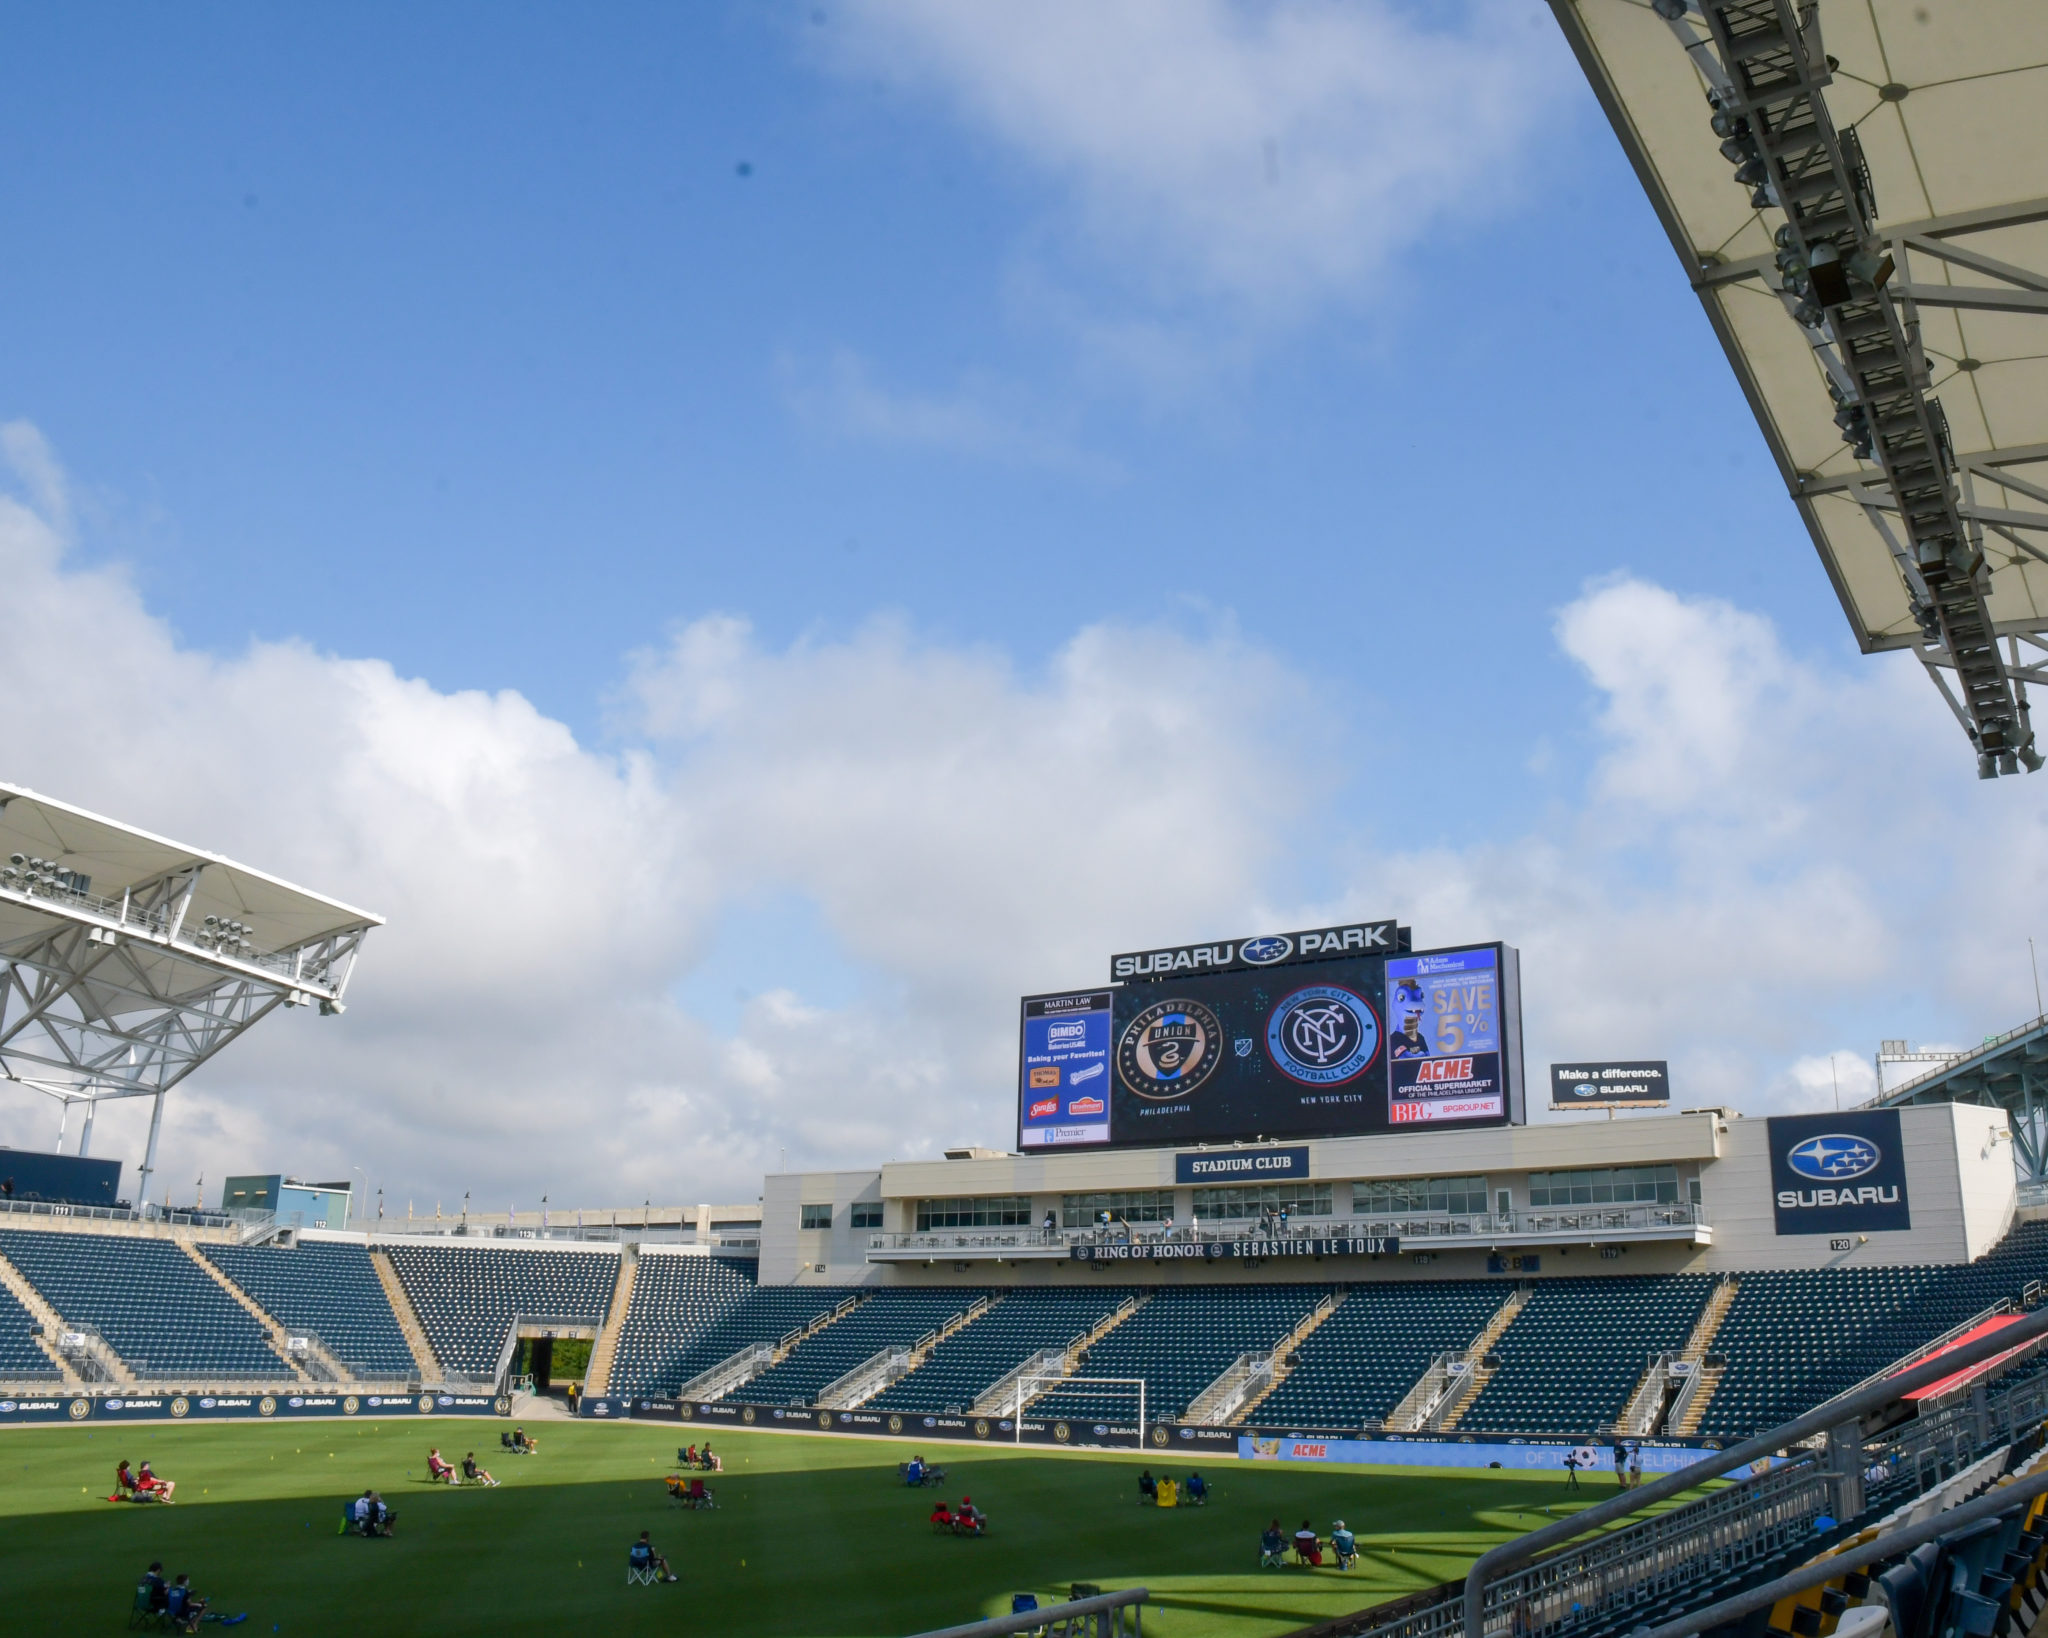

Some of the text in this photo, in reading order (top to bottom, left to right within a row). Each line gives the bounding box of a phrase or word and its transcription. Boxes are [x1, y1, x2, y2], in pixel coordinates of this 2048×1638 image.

[1115, 925, 1390, 977] SUBARU PARK
[1330, 989, 1355, 1003] CITY
[1433, 985, 1491, 1014] SAVE
[1044, 997, 1092, 1009] MARTIN LAW
[1125, 1003, 1218, 1046] PHILADELPHIA
[1050, 1025, 1084, 1039] BIMBO
[1154, 1025, 1192, 1039] UNION
[1027, 1055, 1052, 1063] Baking
[1053, 1054, 1069, 1062] your
[1282, 1053, 1367, 1081] FOOTBALL CLUB
[1416, 1057, 1474, 1084] ACME
[1558, 1068, 1662, 1080] Make a difference.
[1398, 1079, 1493, 1094] OFFICIAL SUPERMARKET
[1600, 1085, 1648, 1094] SUBARU
[1300, 1094, 1364, 1105] NEW YORK CITY
[1139, 1105, 1191, 1117] PHILADELPHIA
[1443, 1102, 1496, 1113] BPGROUP.NET
[1055, 1127, 1085, 1138] Premier
[1192, 1156, 1292, 1173] STADIUM CLUB
[1777, 1185, 1899, 1208] SUBARU
[54, 1206, 69, 1215] 111
[315, 1220, 327, 1229] 112
[1094, 1246, 1129, 1258] RING
[1131, 1245, 1150, 1258] OF
[1153, 1244, 1204, 1258] HONOR
[1233, 1241, 1314, 1257] SEBASTIEN
[1322, 1239, 1339, 1254] LE
[1347, 1238, 1386, 1254] TOUX
[1831, 1240, 1849, 1250] 120
[19, 1402, 59, 1410] SUBARU
[125, 1400, 161, 1408] SUBARU
[305, 1398, 336, 1406] SUBARU
[712, 1406, 736, 1414] SUBARU
[854, 1415, 881, 1423] SUBARU
[1292, 1444, 1327, 1457] ACME
[1525, 1451, 1545, 1465] OF
